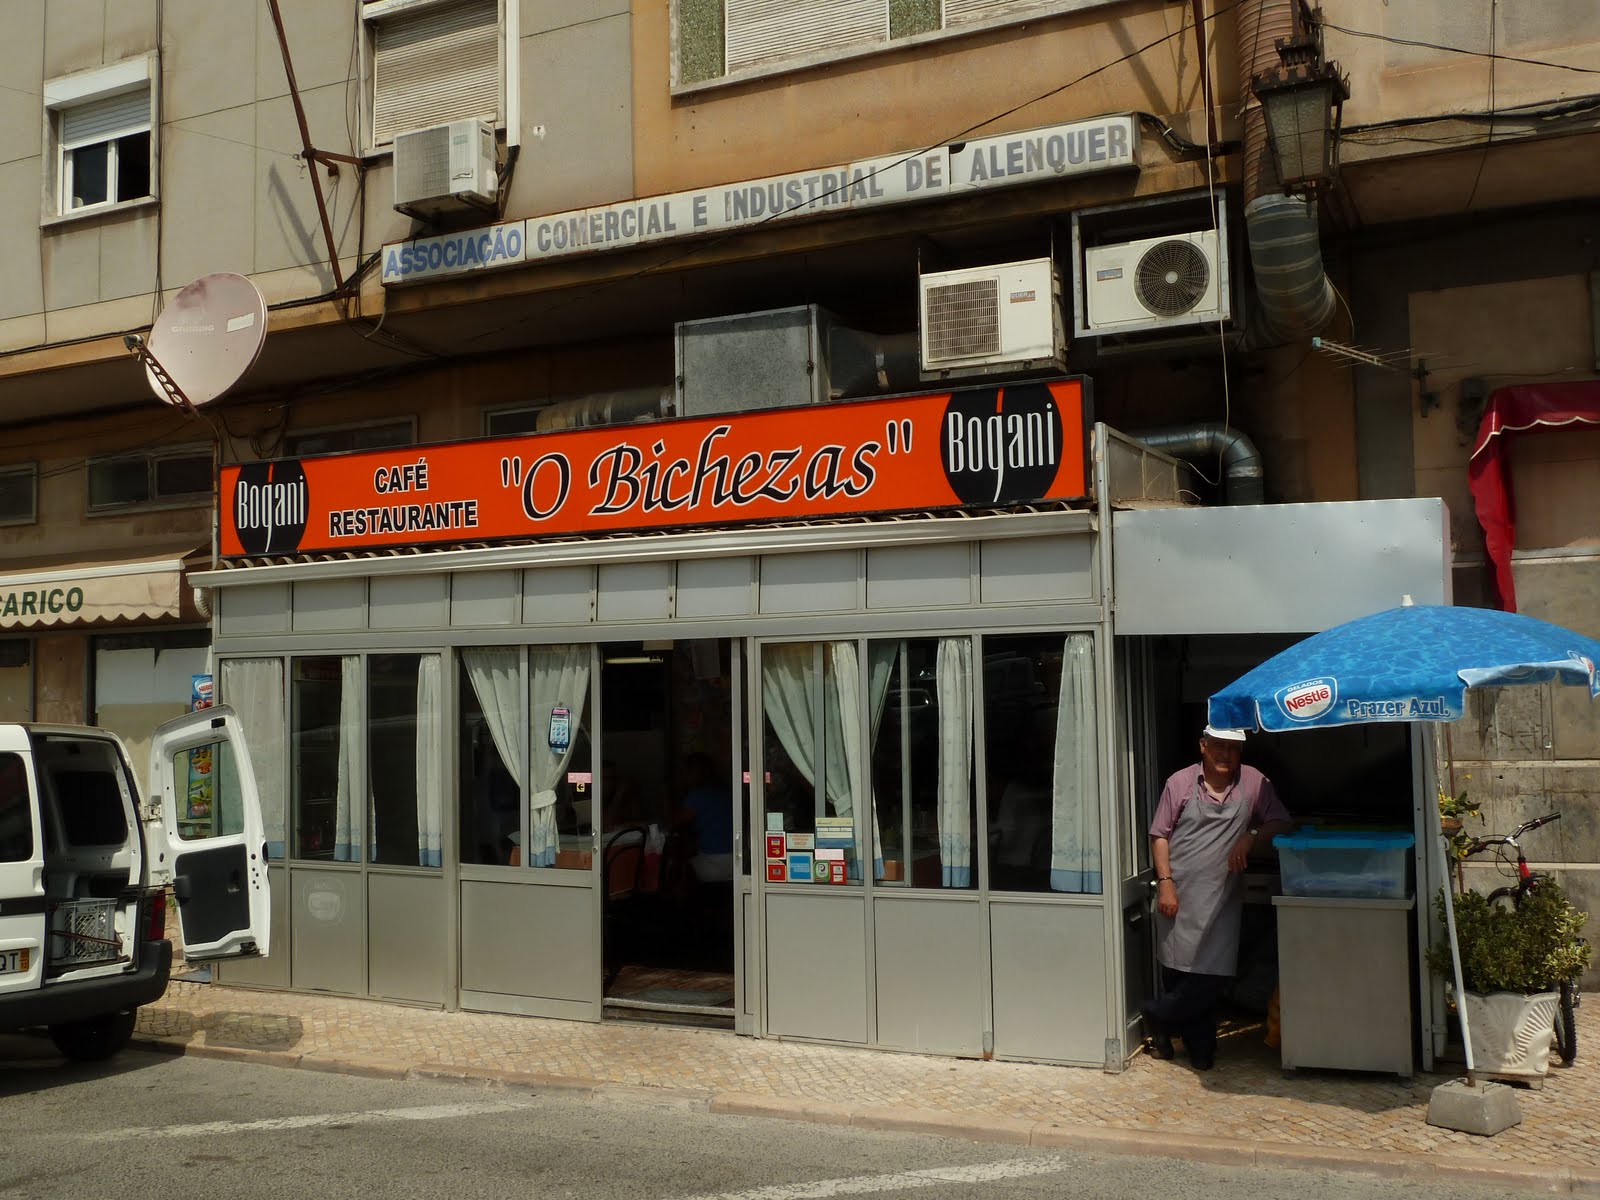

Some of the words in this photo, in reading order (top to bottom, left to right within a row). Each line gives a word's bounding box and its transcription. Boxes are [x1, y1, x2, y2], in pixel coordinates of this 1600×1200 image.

[384, 226, 522, 278] ASSOCIAÇÃO
[537, 201, 677, 252] COMERCIAL
[693, 195, 708, 227] E
[724, 165, 884, 223] INDUSTRIAL
[905, 154, 943, 192] DE
[969, 123, 1128, 182] ALENQUER
[948, 403, 1055, 503] Bogani
[374, 457, 428, 495] CAFÉ
[238, 475, 305, 553] Bogani
[328, 499, 478, 538] RESTAURANTE
[0, 587, 84, 617] ARICO
[1287, 679, 1324, 693] GELADOS
[1347, 699, 1406, 719] Prazer
